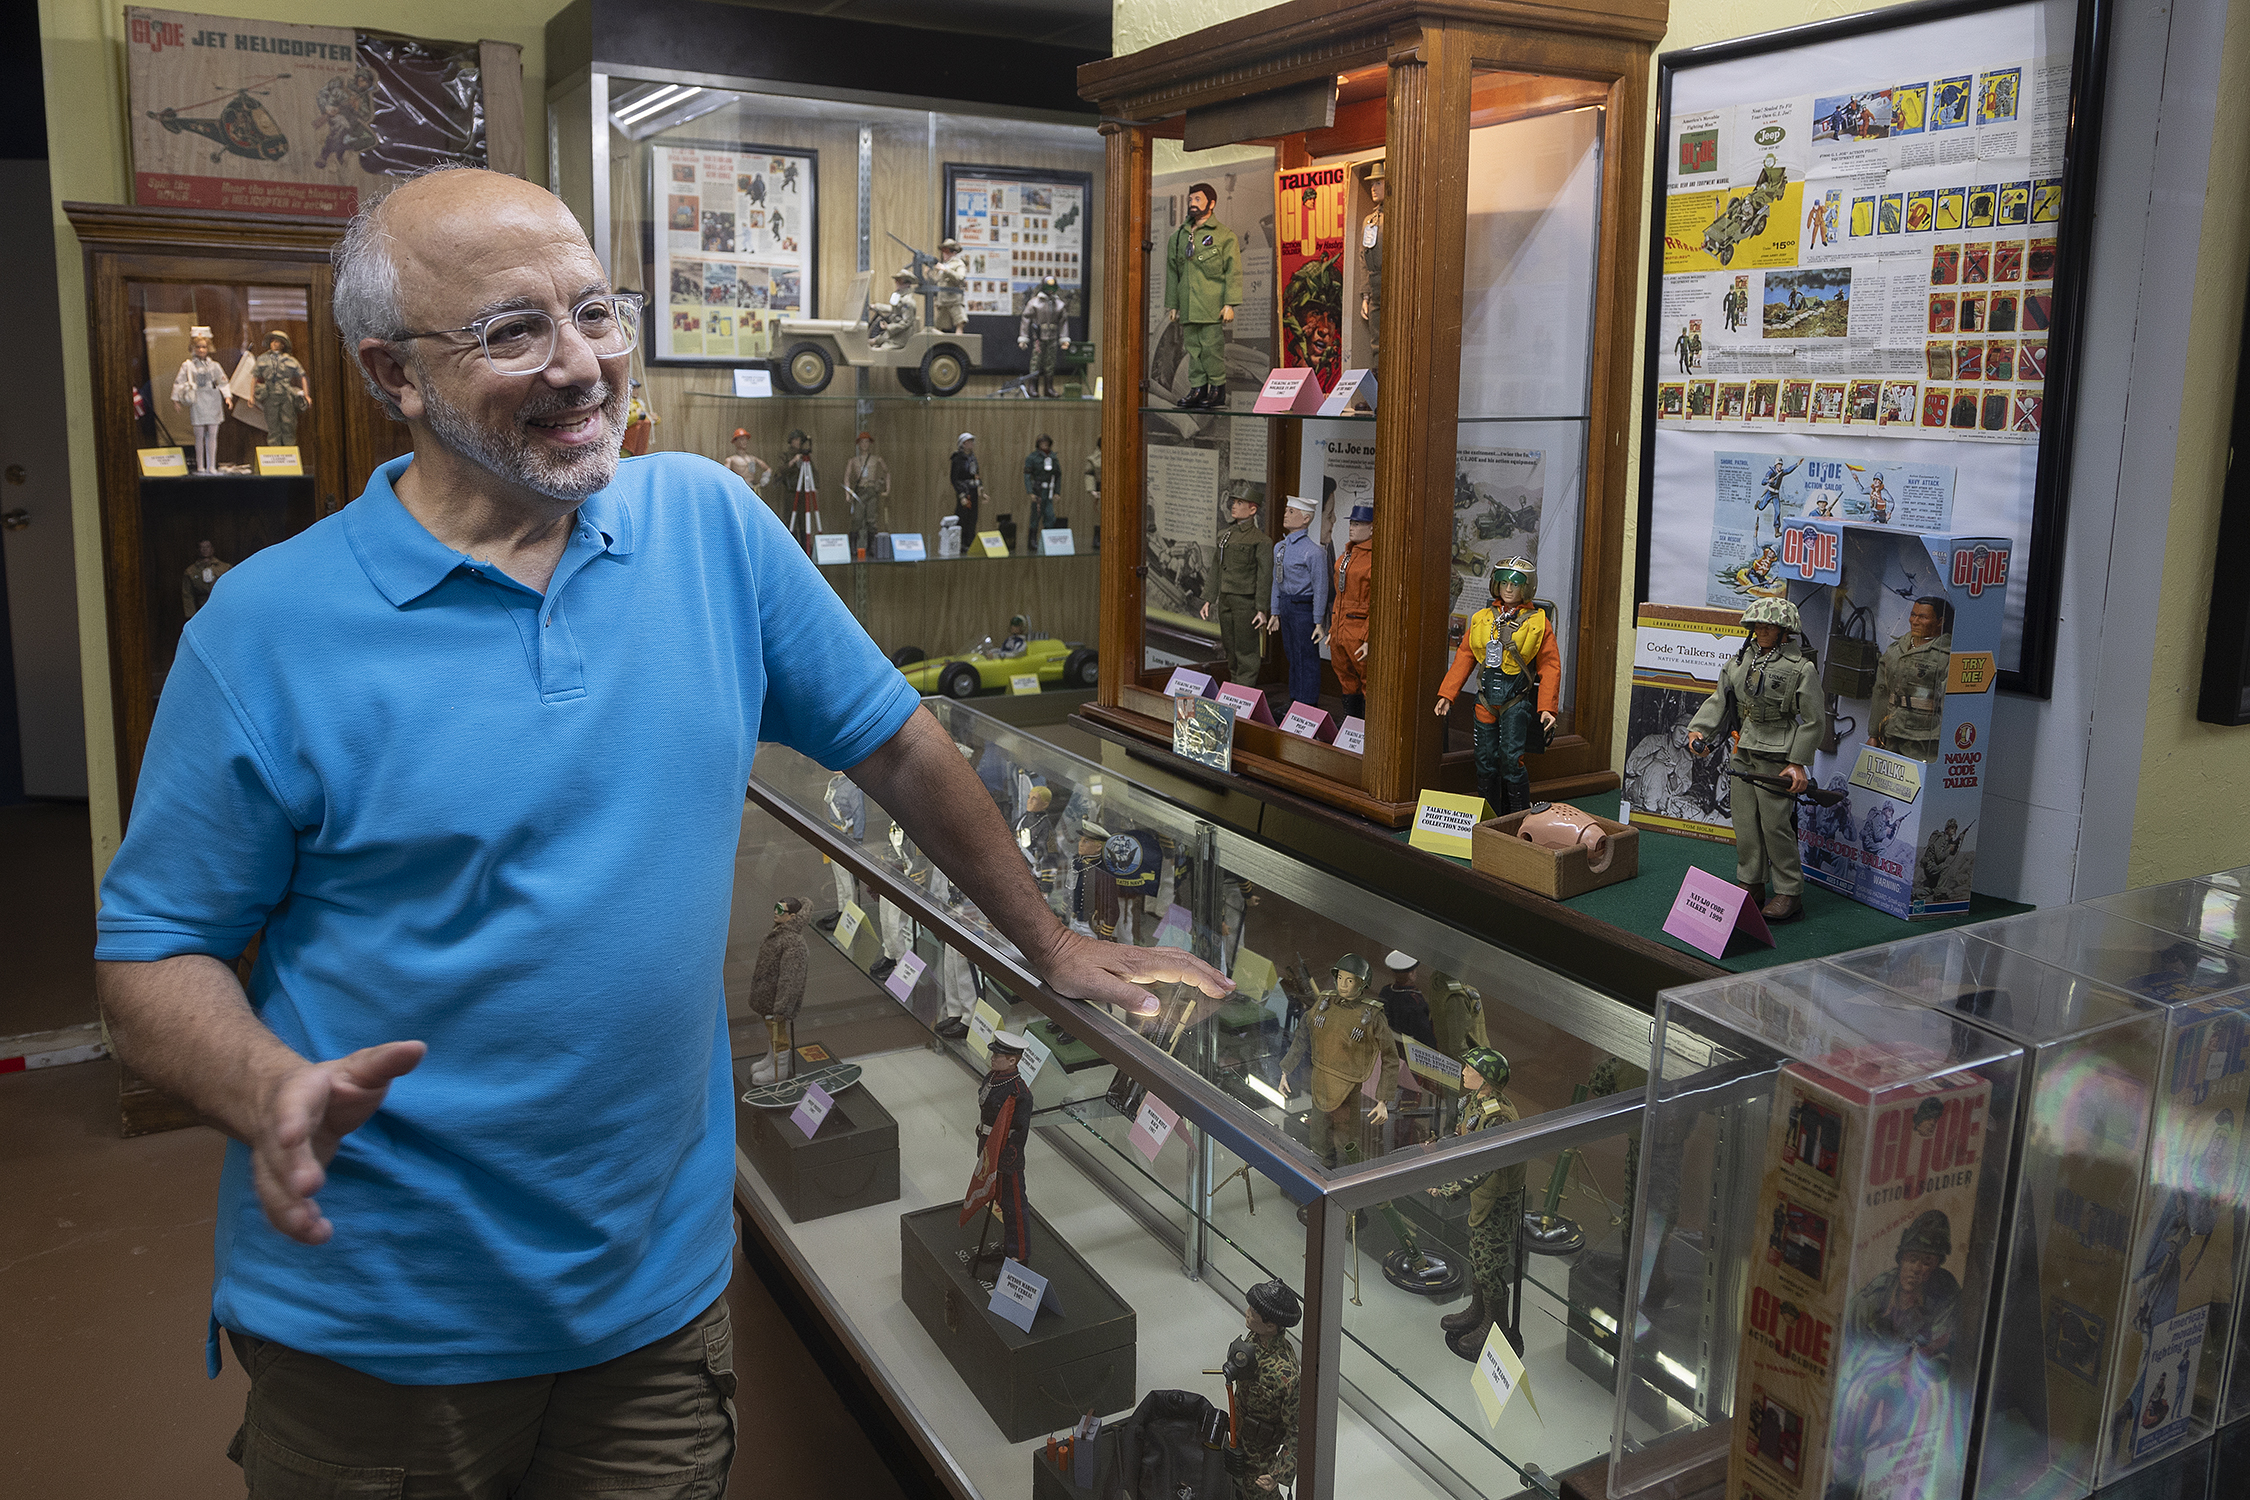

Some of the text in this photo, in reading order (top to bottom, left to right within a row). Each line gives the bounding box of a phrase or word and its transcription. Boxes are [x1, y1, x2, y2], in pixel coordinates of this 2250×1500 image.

[191, 30, 352, 62] JET HELICOPTER
[1316, 242, 1323, 251] by
[1327, 442, 1344, 454] G.I.
[1344, 442, 1361, 455] Joe
[1804, 481, 1823, 490] ACTION
[1646, 642, 1674, 654] Code
[1676, 645, 1716, 660] Talkers
[1681, 659, 1716, 667] AMERICANS
[1962, 658, 1986, 670] TRY
[1768, 674, 1786, 683] USMC
[1960, 671, 1983, 683] ME!
[1943, 751, 1982, 765] NAVAJO
[1866, 754, 1905, 781] I TALK!
[1947, 764, 1976, 776] CODE
[1867, 771, 1874, 785] 7
[1942, 776, 1978, 789] TALKER
[1424, 812, 1472, 826] PILOT TIMELESS
[1425, 805, 1474, 819] TALKING ACTION
[1421, 819, 1472, 834] COLLECTION 2000
[1682, 823, 1714, 833] TOM HOLM
[1825, 838, 1904, 878] CODE TALKER
[1873, 875, 1902, 893] WARNING:
[1685, 899, 1723, 923] TALKER 1999
[1689, 892, 1726, 915] NAVAJO CODE
[1866, 1169, 1973, 1207] ACTION SOLDIER
[1872, 1210, 1915, 1241] HASBRO
[1006, 1274, 1037, 1294] ACTION MARINE
[1006, 1282, 1033, 1300] POST CEREAL
[2167, 1308, 2206, 1334] America's
[1748, 1329, 1780, 1353] ACTION
[2171, 1323, 2205, 1343] movable
[2151, 1334, 2203, 1364] fighting man
[1486, 1350, 1510, 1390] HEAVY WEAPONS
